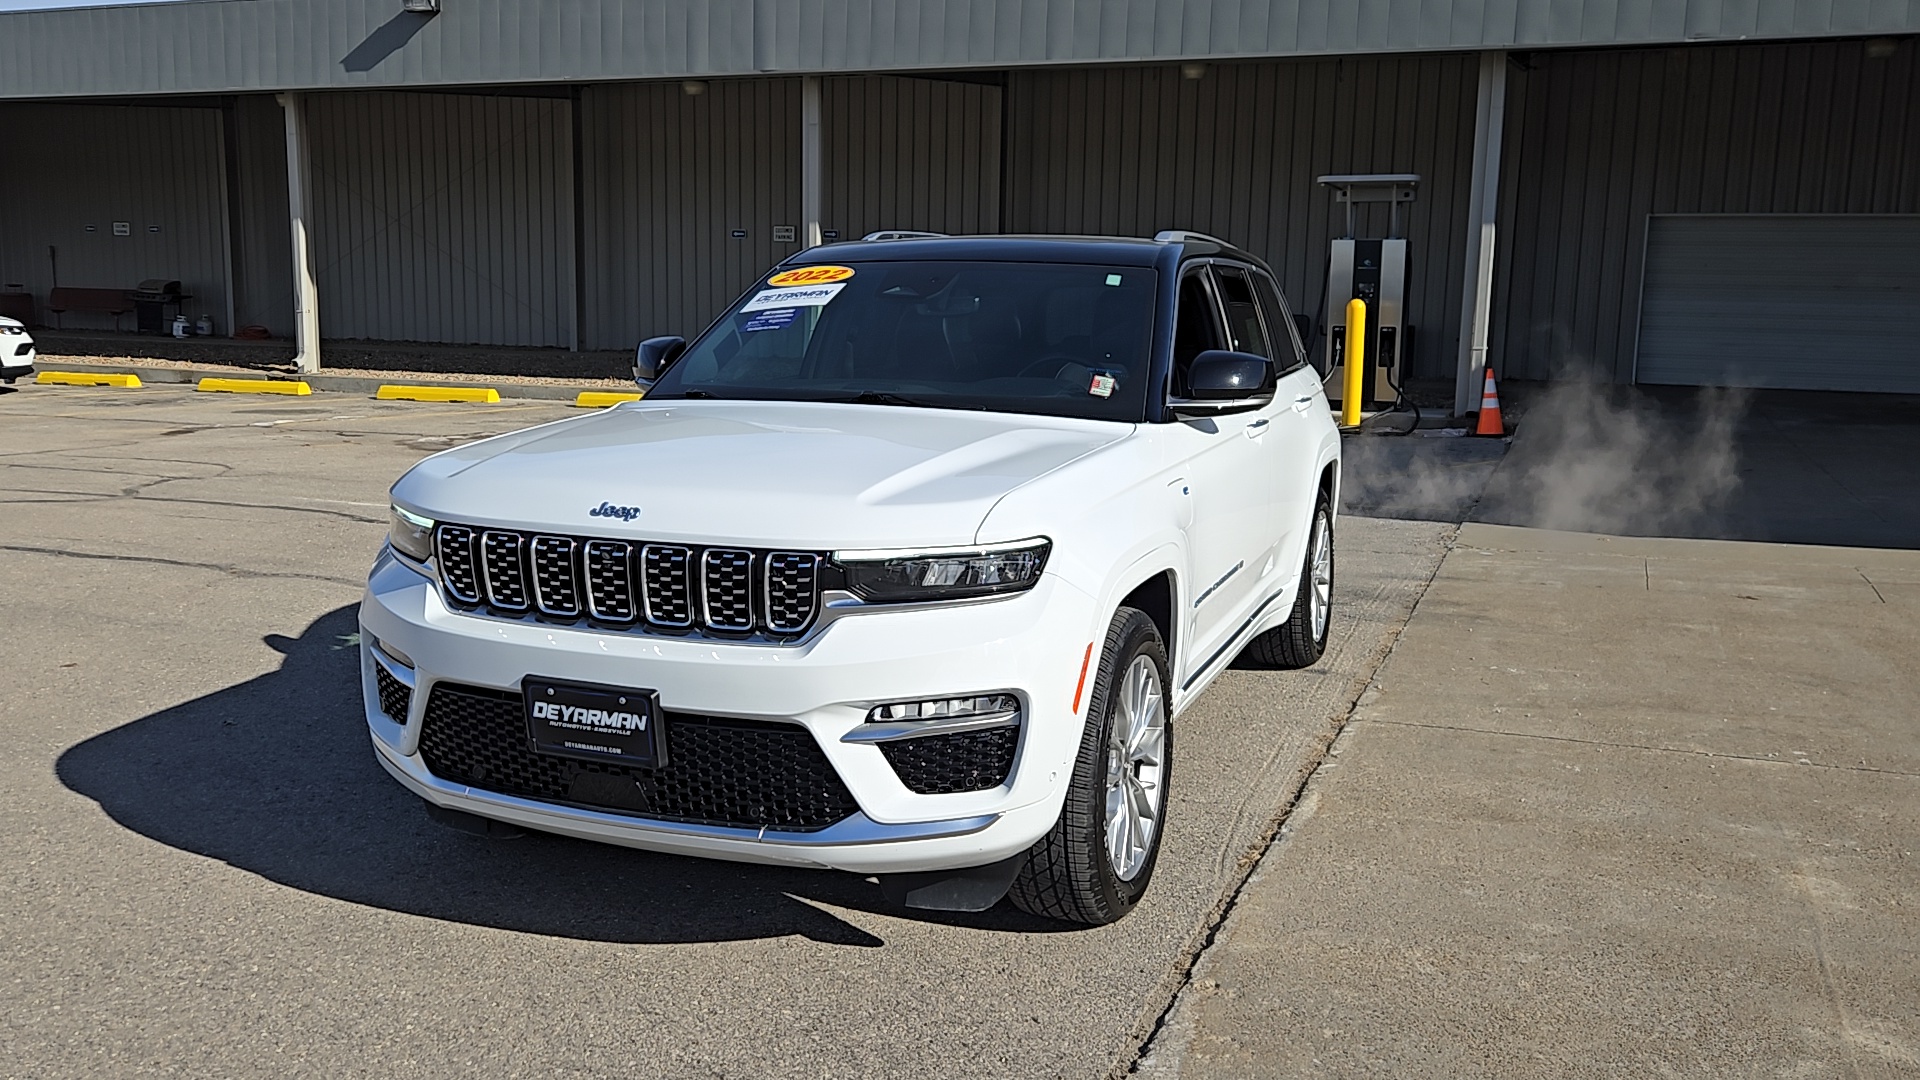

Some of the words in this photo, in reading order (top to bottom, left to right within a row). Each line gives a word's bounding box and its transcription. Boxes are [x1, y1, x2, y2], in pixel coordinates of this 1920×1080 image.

[773, 269, 849, 283] 2022
[755, 290, 834, 303] DEYARMAN
[589, 501, 641, 522] Jeep
[533, 701, 647, 731] DEYARMAN
